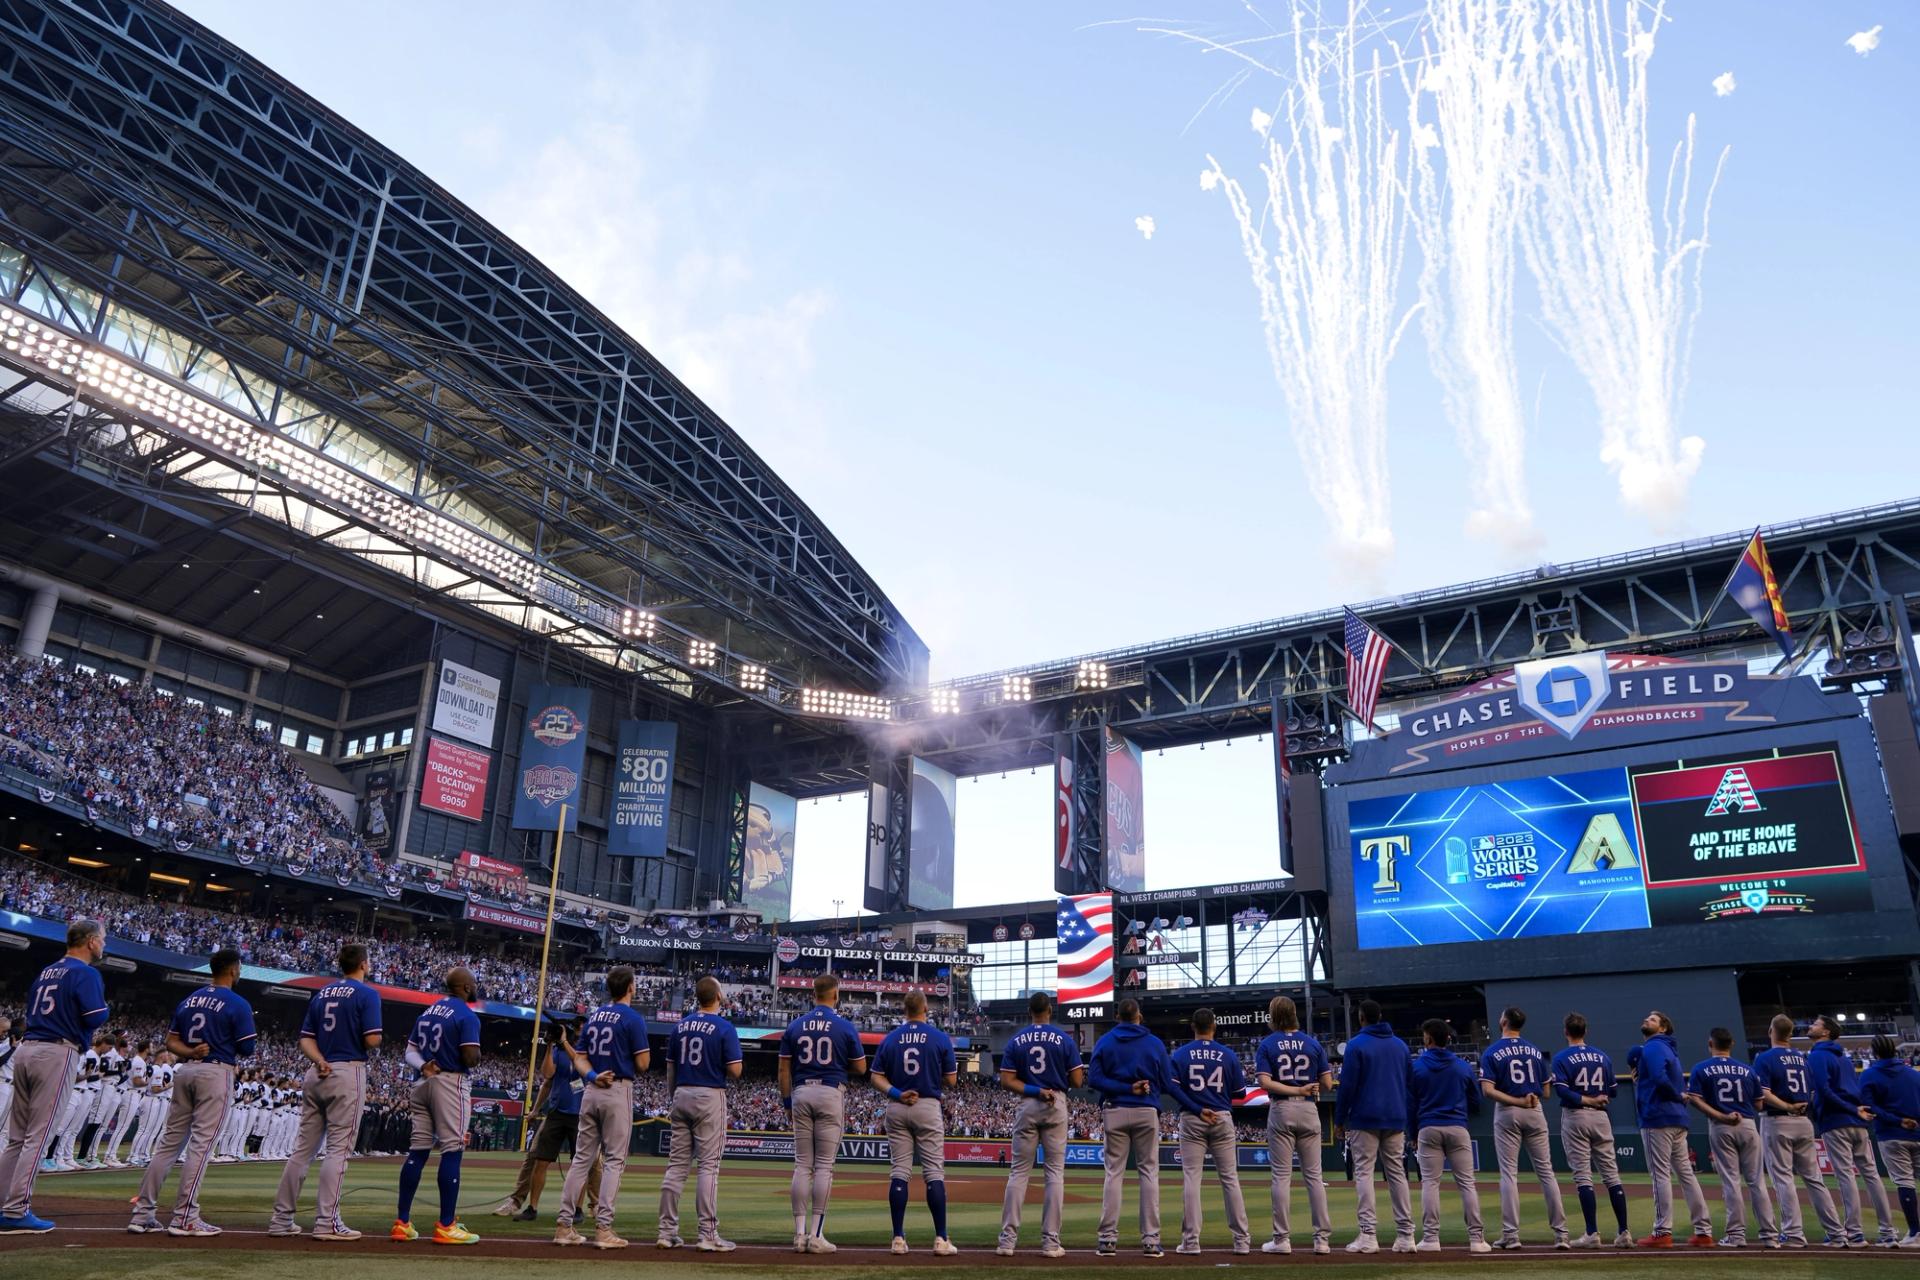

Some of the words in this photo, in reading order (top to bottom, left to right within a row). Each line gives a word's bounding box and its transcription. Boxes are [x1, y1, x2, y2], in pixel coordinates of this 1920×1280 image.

[458, 673, 482, 686] CAESARS
[440, 688, 484, 716] DOWNLOAD
[486, 706, 495, 720] IT
[1412, 698, 1513, 737] CHASE
[1620, 674, 1734, 699] FIELD
[450, 711, 460, 719] USE
[545, 714, 568, 732] 25
[1450, 738, 1486, 751] HOME
[1494, 733, 1510, 742] OF
[1520, 726, 1544, 737] THE
[1593, 710, 1697, 726] DIAMONDBACKS
[623, 748, 669, 757] CELEBRATING
[622, 756, 668, 782] $80
[437, 774, 476, 793] LOCATION
[619, 782, 666, 794] MILLION
[440, 794, 467, 808] 69050
[617, 803, 663, 812] CHARITABLE
[616, 812, 663, 827] GIVING
[1496, 833, 1534, 846] 2023
[1689, 832, 1719, 846] AND
[1722, 828, 1750, 843] THE
[1754, 824, 1796, 840] HOME
[1471, 845, 1537, 864] WORLD
[1694, 847, 1713, 861] OF
[1716, 844, 1743, 859] THE
[1747, 839, 1796, 855] BRAVE
[1474, 859, 1539, 879] SERIES
[1213, 884, 1239, 894] WORLD
[1240, 880, 1286, 892] CHAMPIONS
[1579, 876, 1633, 885] DIAMONDBACKS
[1720, 880, 1768, 892] WELCOME
[1773, 879, 1786, 887] TO
[1120, 895, 1130, 903] NL
[1132, 893, 1151, 902] WEST
[1154, 889, 1197, 900] CHAMPIONS
[1711, 901, 1741, 911] CHASE
[479, 910, 522, 925] ALL-YOU-CAN-EAT
[523, 920, 538, 929] SEATS
[662, 938, 671, 948] &
[801, 947, 832, 957] COLD
[835, 948, 872, 959] BEERS
[874, 951, 882, 960] &
[884, 951, 983, 965] CHEESEBURGERS
[1138, 956, 1156, 965] WILD
[1159, 954, 1179, 963] CARD
[32, 984, 58, 1016] 15
[318, 986, 355, 999] SEAGER
[184, 996, 225, 1013] SEMIEN
[323, 1002, 339, 1032] 5
[1067, 1008, 1086, 1018] 4:51
[1090, 1007, 1104, 1017] PM
[1213, 1014, 1252, 1025] anner
[1254, 1011, 1271, 1024] He
[188, 1012, 206, 1043] 2
[678, 1020, 716, 1035] GARVER
[802, 1020, 832, 1032] LOWE
[417, 1020, 443, 1051] 53
[586, 1026, 613, 1056] 32
[899, 1033, 927, 1044] JUNG
[1014, 1031, 1063, 1047] TAVERAS
[679, 1036, 704, 1066] 18
[797, 1036, 833, 1065] 30
[1277, 1040, 1304, 1051] GRAY
[1029, 1046, 1046, 1075] 3
[1190, 1050, 1224, 1062] PEREZ
[1493, 1046, 1542, 1061] BRADFORD
[1568, 1053, 1604, 1065] HEANEY
[1780, 1055, 1805, 1067] SMITH
[903, 1048, 921, 1076] 6
[1277, 1054, 1310, 1080] 22
[1510, 1059, 1535, 1084] 61
[1704, 1065, 1750, 1077] KENNEDY
[1189, 1064, 1224, 1094] 54
[1575, 1067, 1604, 1092] 44
[1786, 1069, 1807, 1094] 51
[1717, 1078, 1743, 1103] 21
[837, 1142, 889, 1158] AVNE
[958, 1153, 993, 1161] Budweiser
[1066, 1149, 1095, 1160] ASE
[1616, 1147, 1634, 1156] 407
